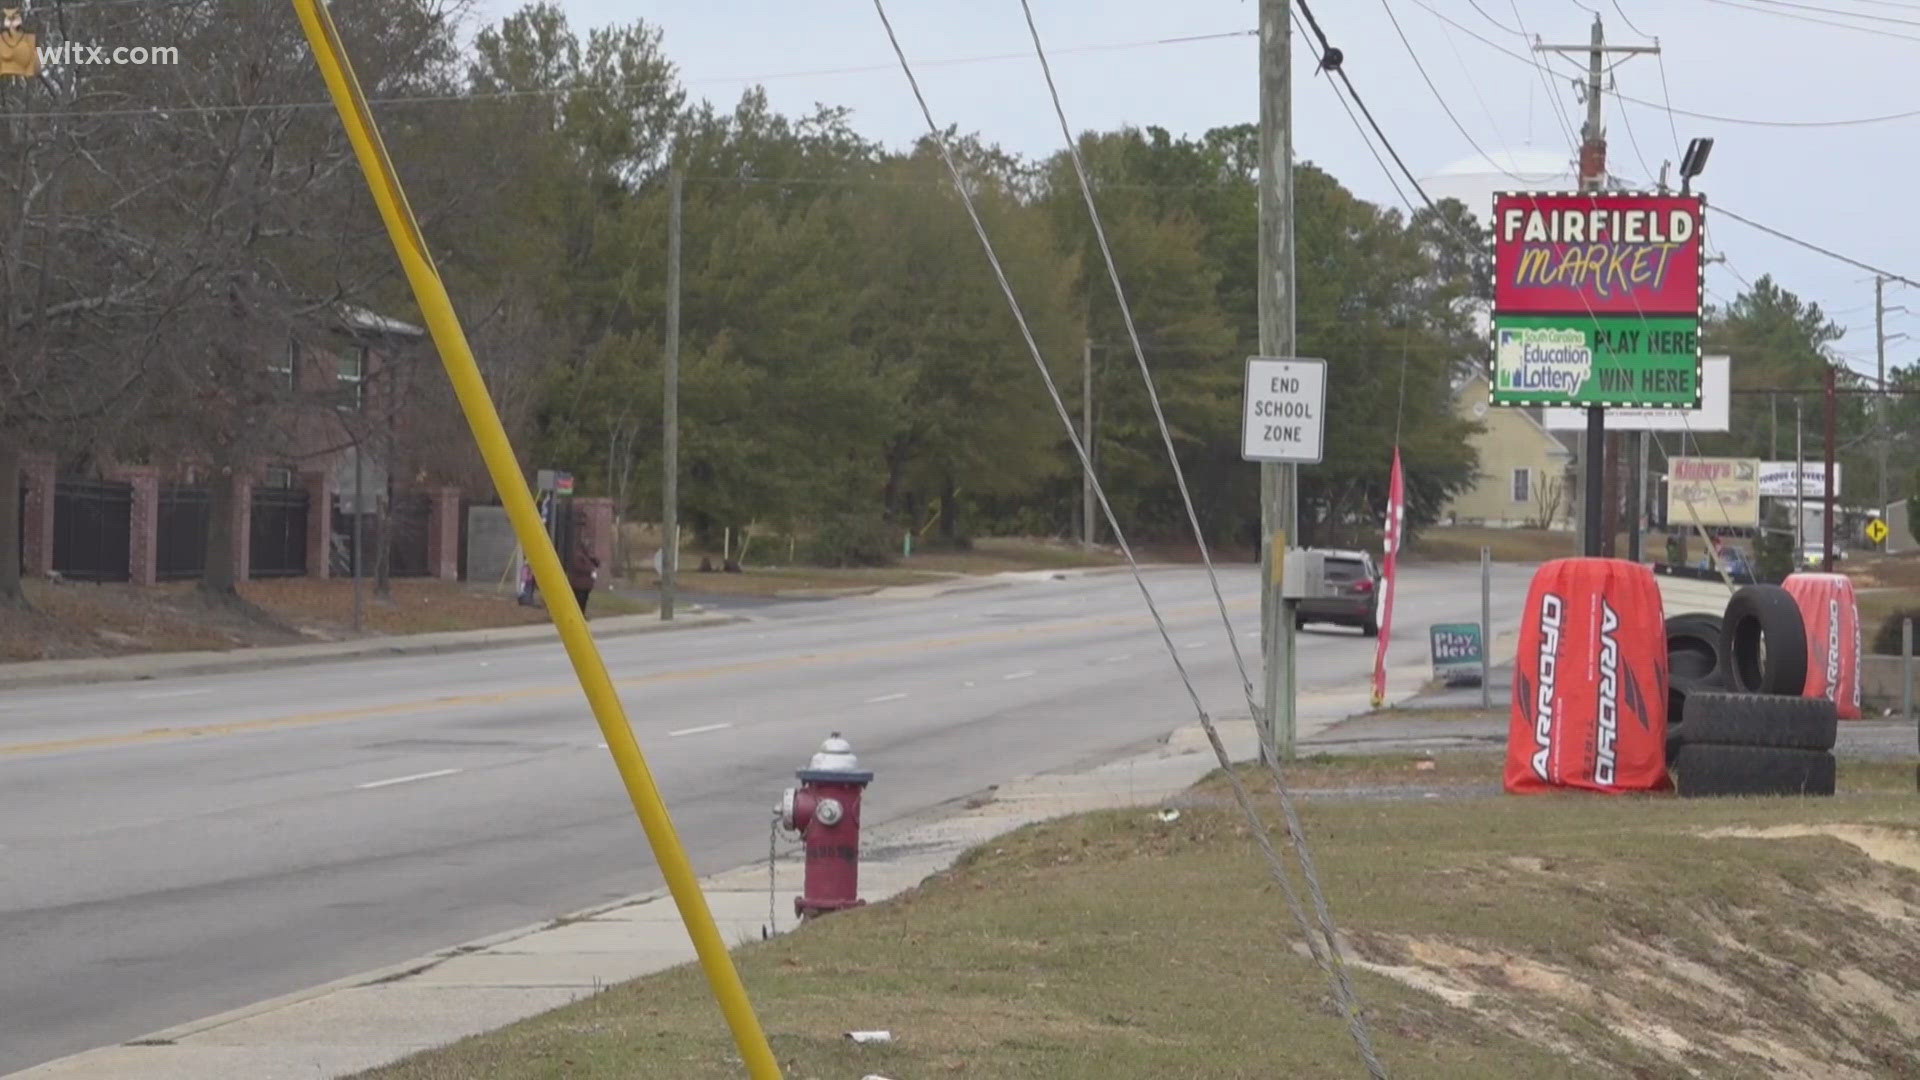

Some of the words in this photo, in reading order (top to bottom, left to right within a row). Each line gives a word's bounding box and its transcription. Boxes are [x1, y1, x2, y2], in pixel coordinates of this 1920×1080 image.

[1504, 210, 1693, 243] FAIRFIELD
[1516, 243, 1680, 295] MARKET
[1524, 330, 1548, 343] South
[1549, 330, 1583, 343] Carolina
[1594, 330, 1640, 354] PLAY
[1648, 331, 1695, 354] HERE
[1524, 344, 1588, 364] Education
[1271, 376, 1299, 394] END
[1524, 366, 1581, 394] Lottery
[1599, 368, 1633, 392] WIN
[1642, 368, 1689, 393] HERE
[1255, 400, 1312, 419] SCHOOL
[1263, 425, 1301, 443] ZONE
[1435, 632, 1473, 648] Play
[1436, 644, 1478, 658] Here
[1826, 599, 1838, 702] ARROYO
[1533, 593, 1562, 781] ARROYO
[1594, 599, 1618, 785] ARROYO
